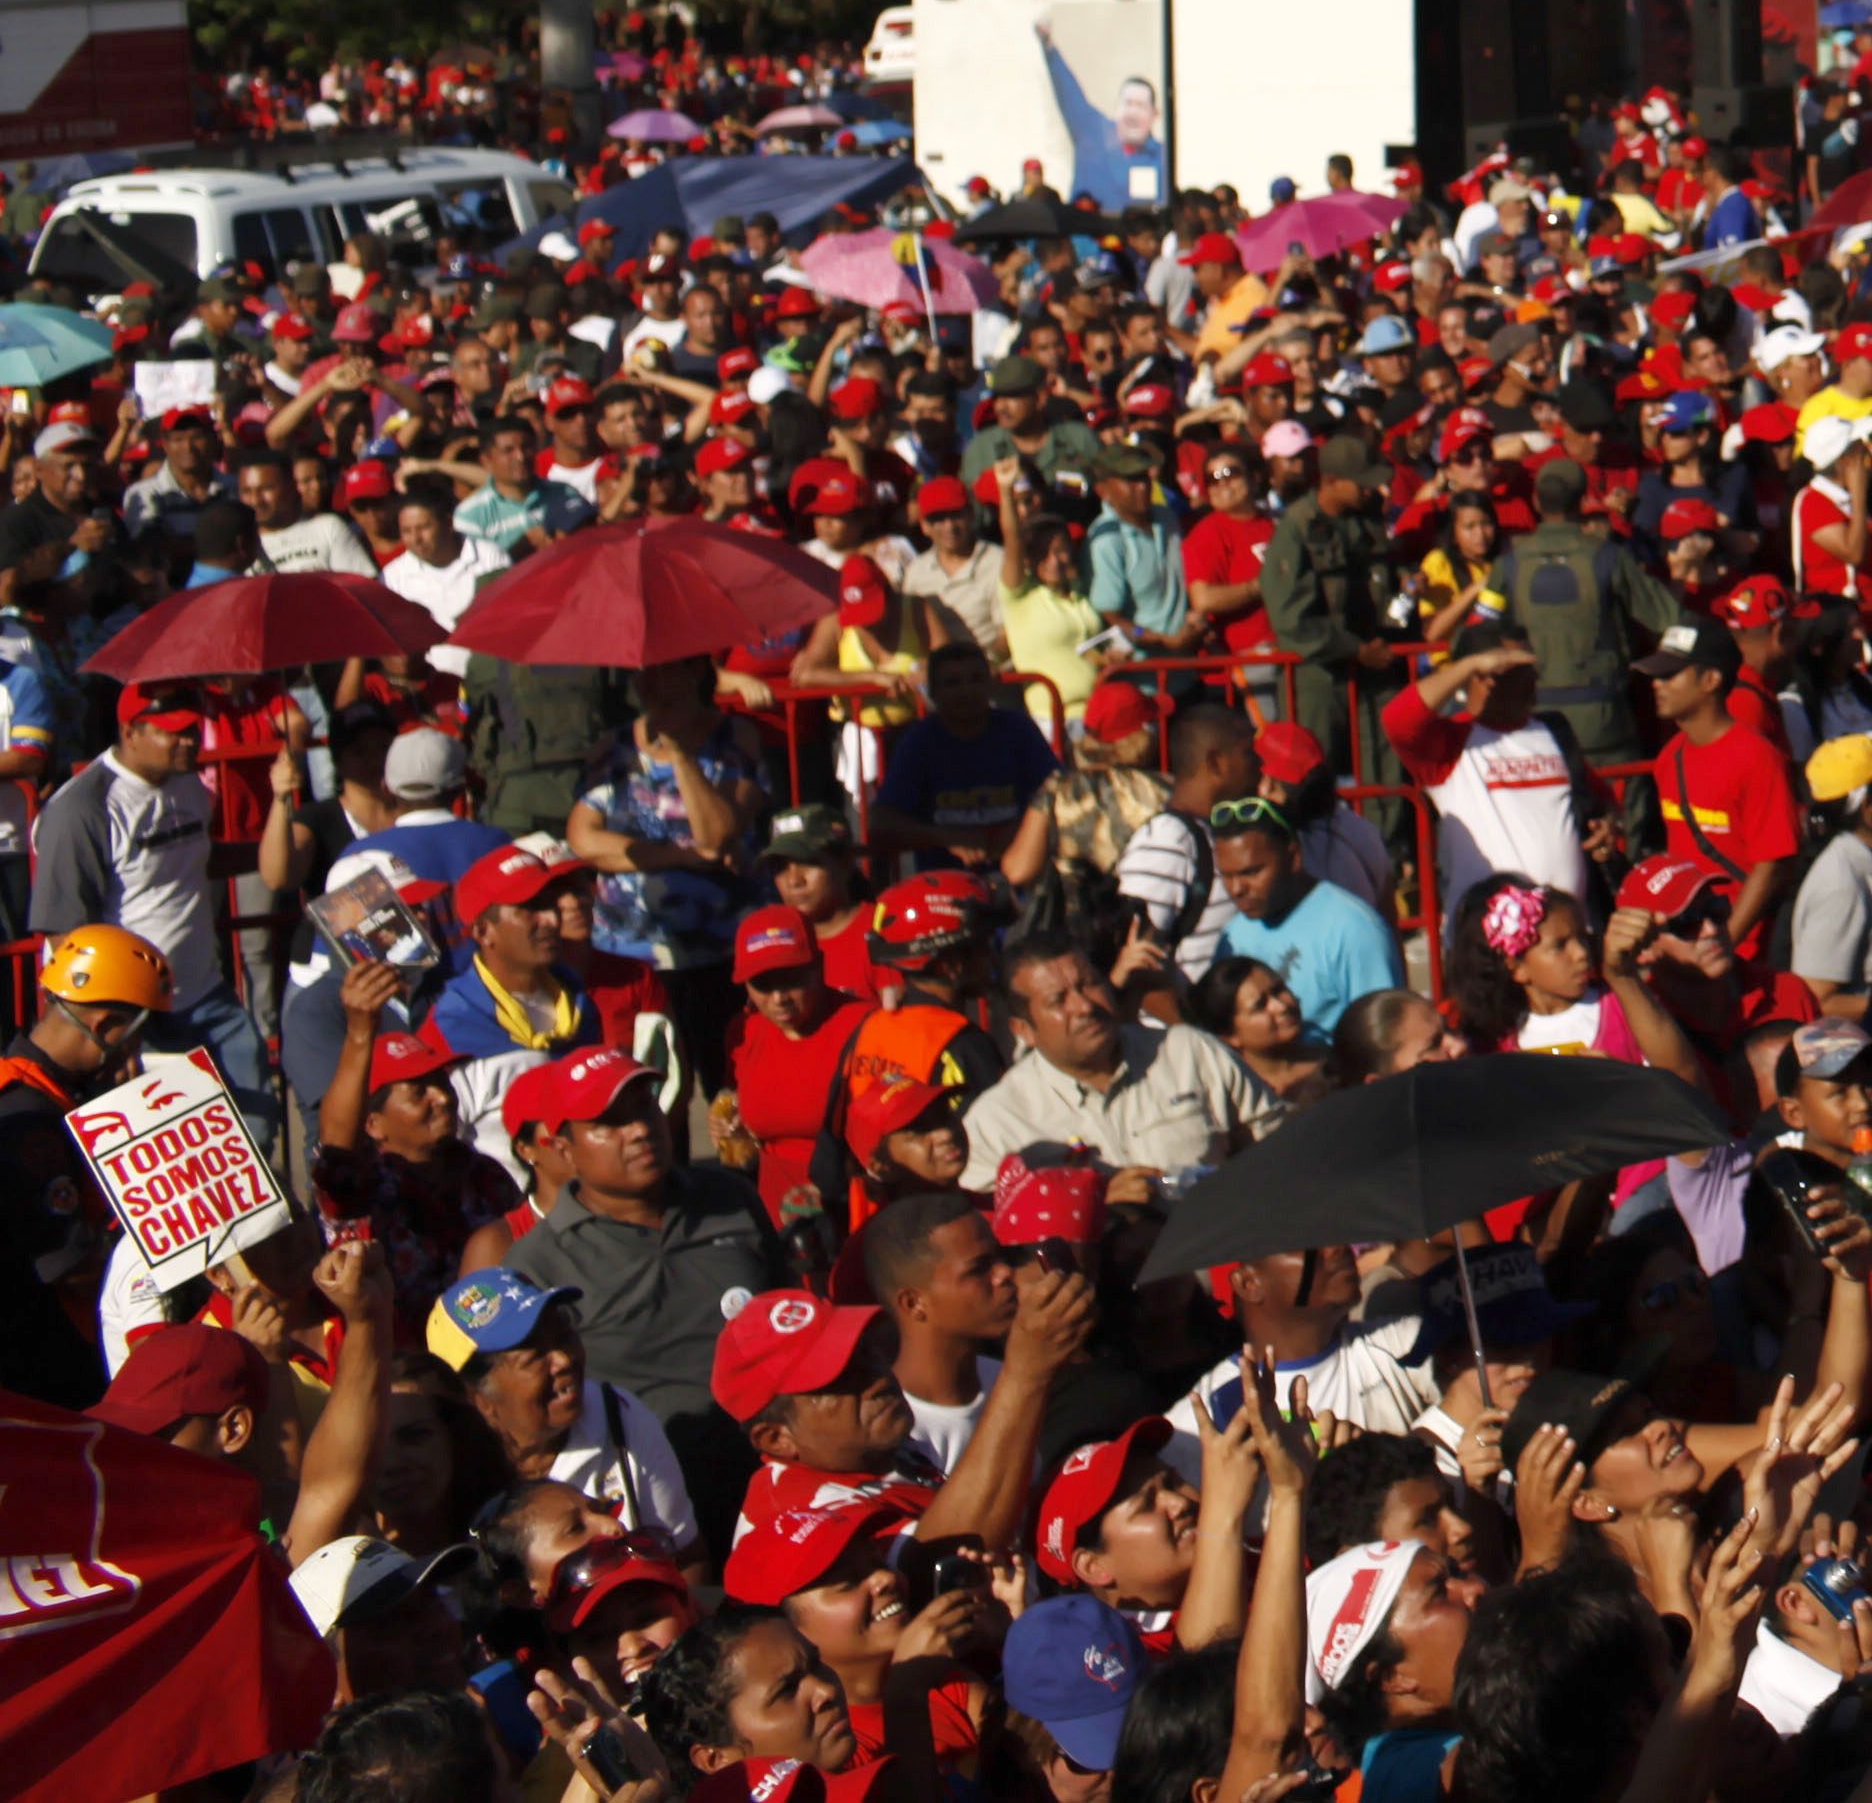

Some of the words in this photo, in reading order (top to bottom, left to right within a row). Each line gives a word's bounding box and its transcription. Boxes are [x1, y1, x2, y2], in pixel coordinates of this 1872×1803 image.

[104, 1105, 234, 1186] TODOS
[122, 1135, 250, 1218] SOMOS
[138, 1164, 271, 1257] CHAVEZ
